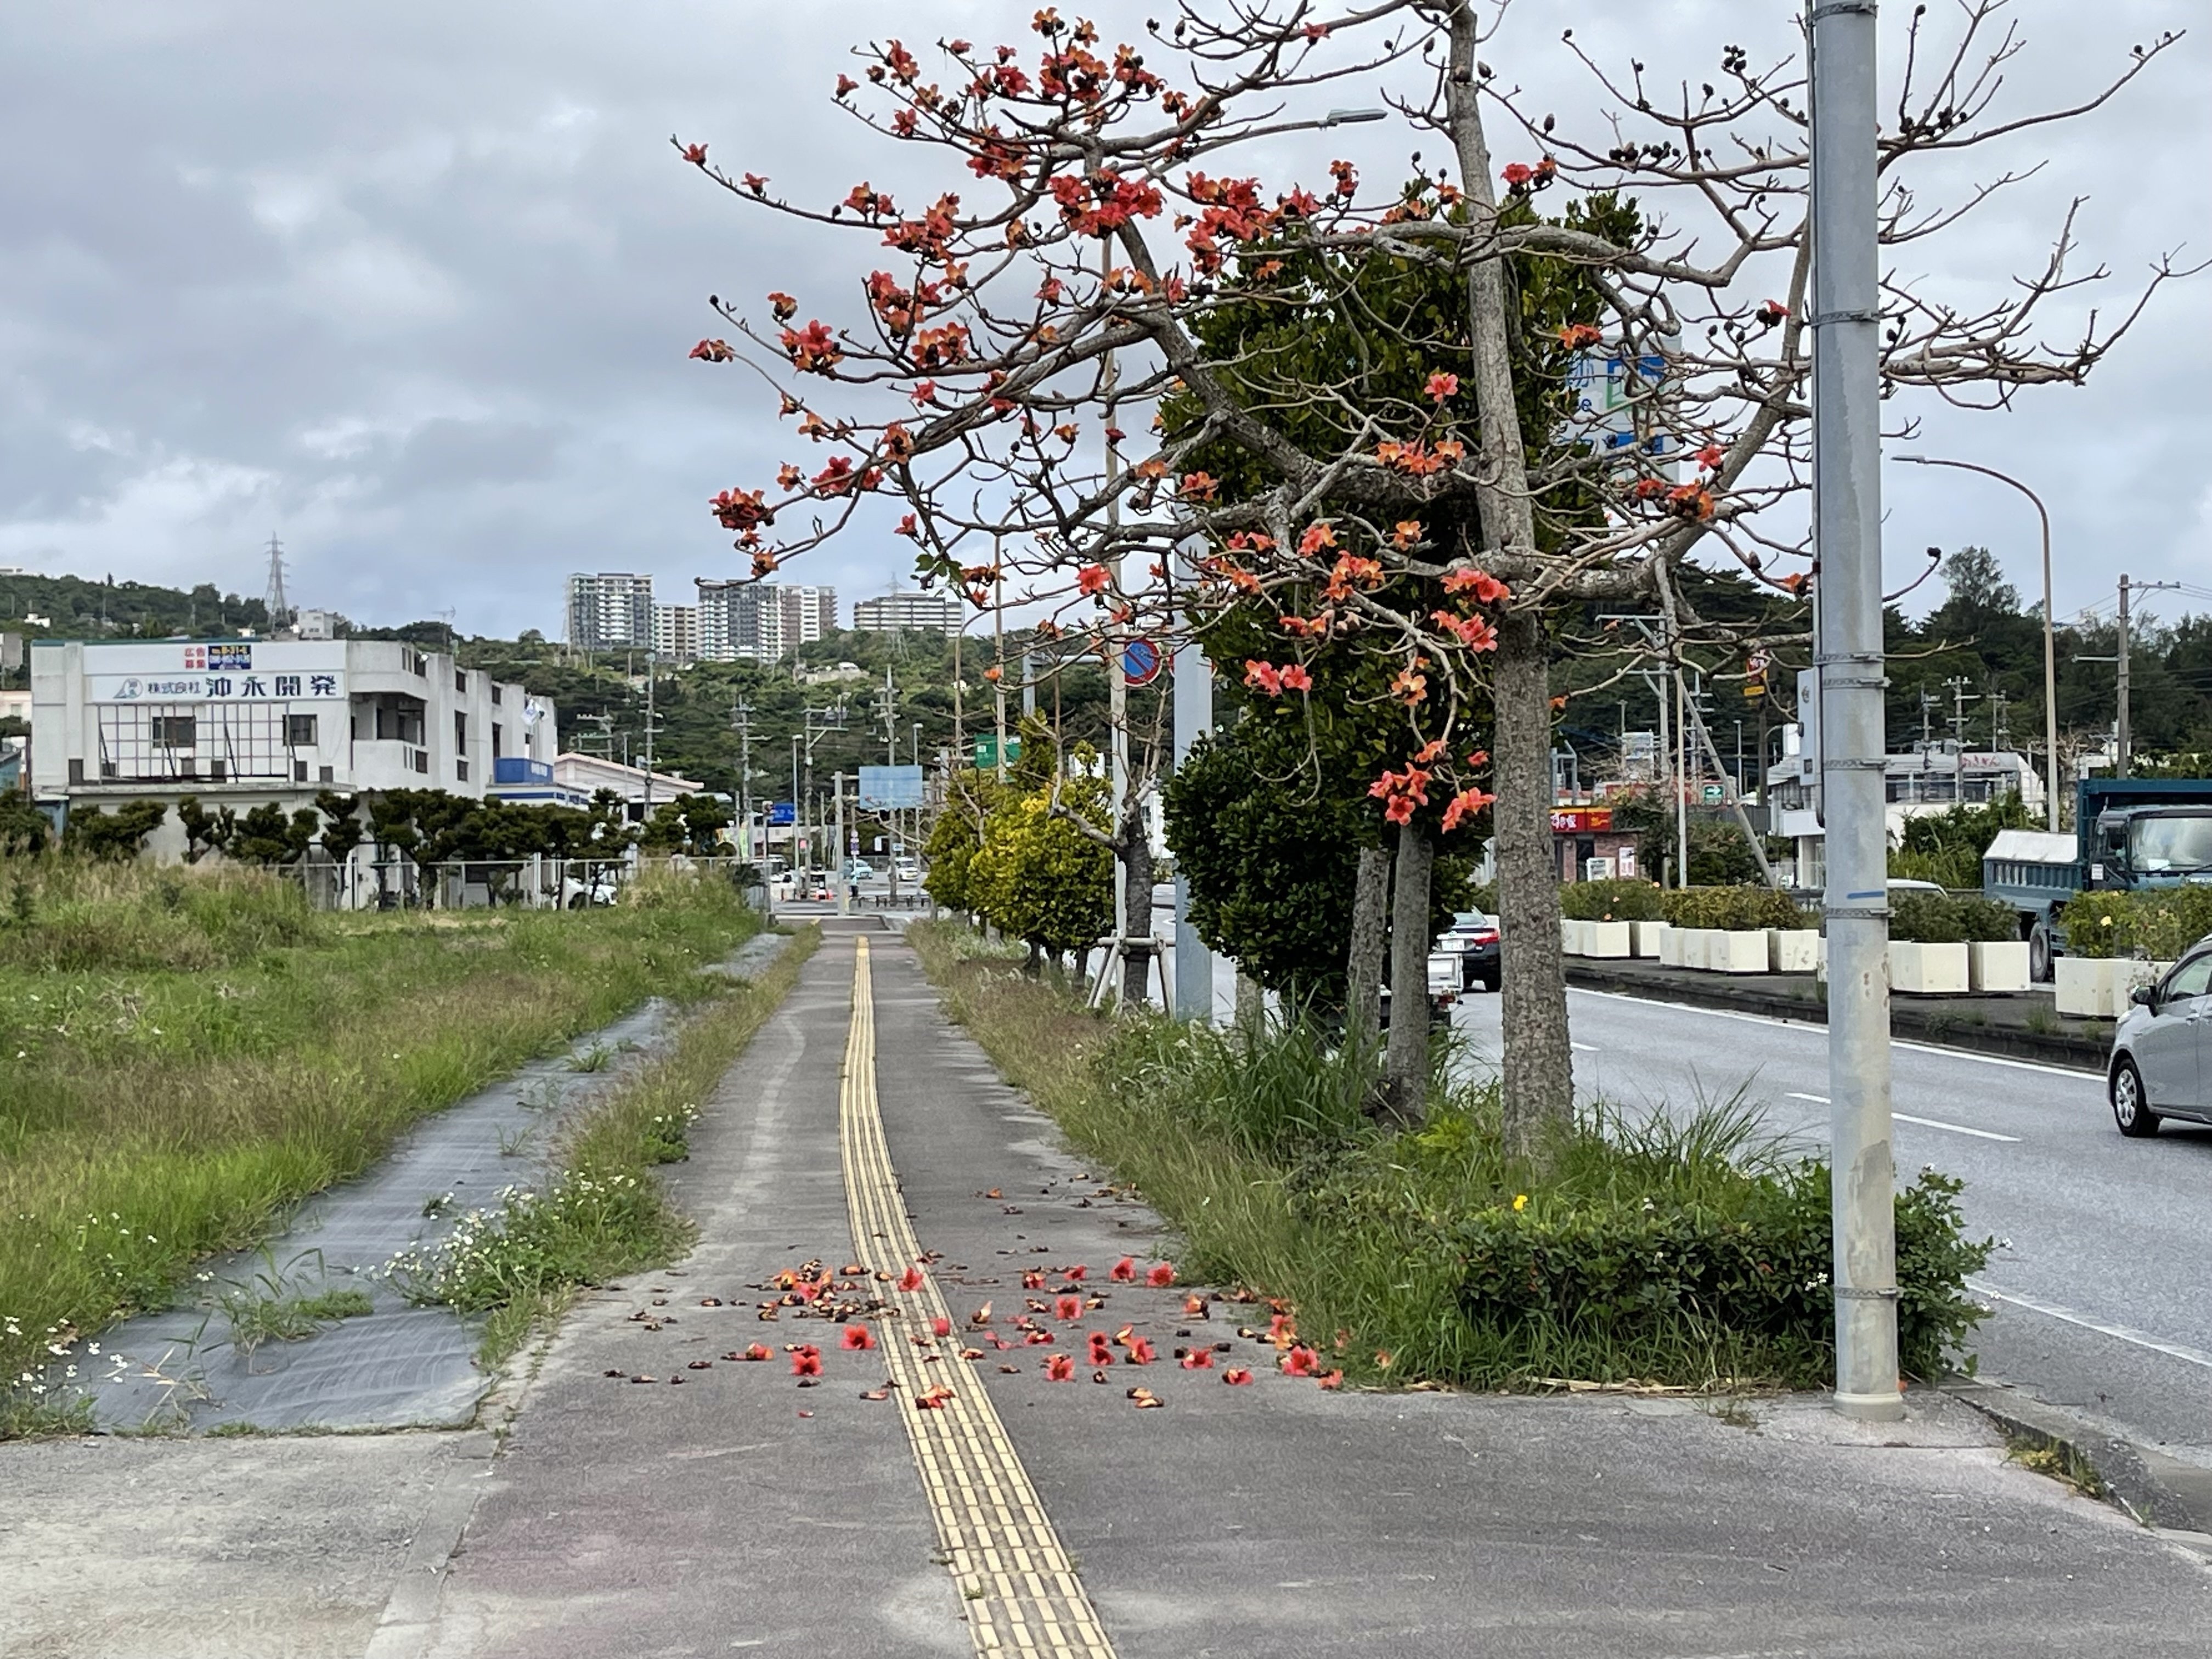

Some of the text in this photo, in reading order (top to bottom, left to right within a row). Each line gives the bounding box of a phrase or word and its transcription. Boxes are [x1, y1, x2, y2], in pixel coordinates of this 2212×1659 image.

[148, 675, 336, 697] 株式会社 沖永開発
